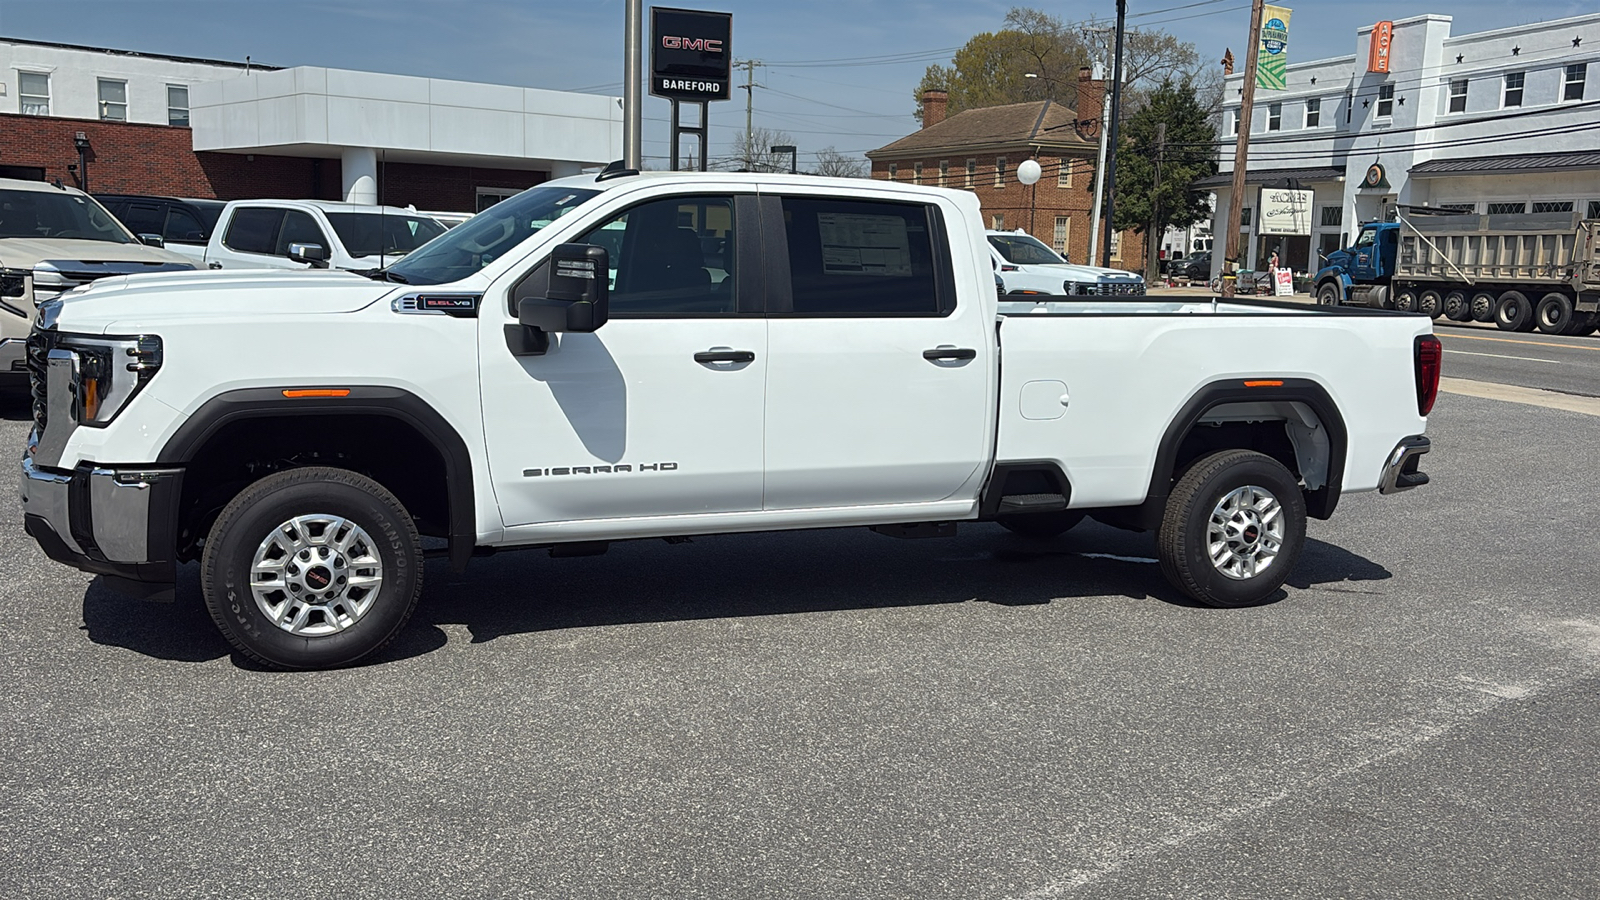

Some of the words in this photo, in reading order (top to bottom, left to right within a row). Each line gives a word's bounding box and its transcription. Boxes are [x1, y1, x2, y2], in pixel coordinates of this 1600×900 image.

[662, 35, 723, 53] GMC
[1378, 24, 1389, 69] ACME
[662, 79, 720, 93] BAREFORD
[1269, 191, 1307, 204] ACME
[523, 464, 632, 477] SIERRA
[639, 462, 678, 472] HD
[308, 571, 329, 585] GMC
